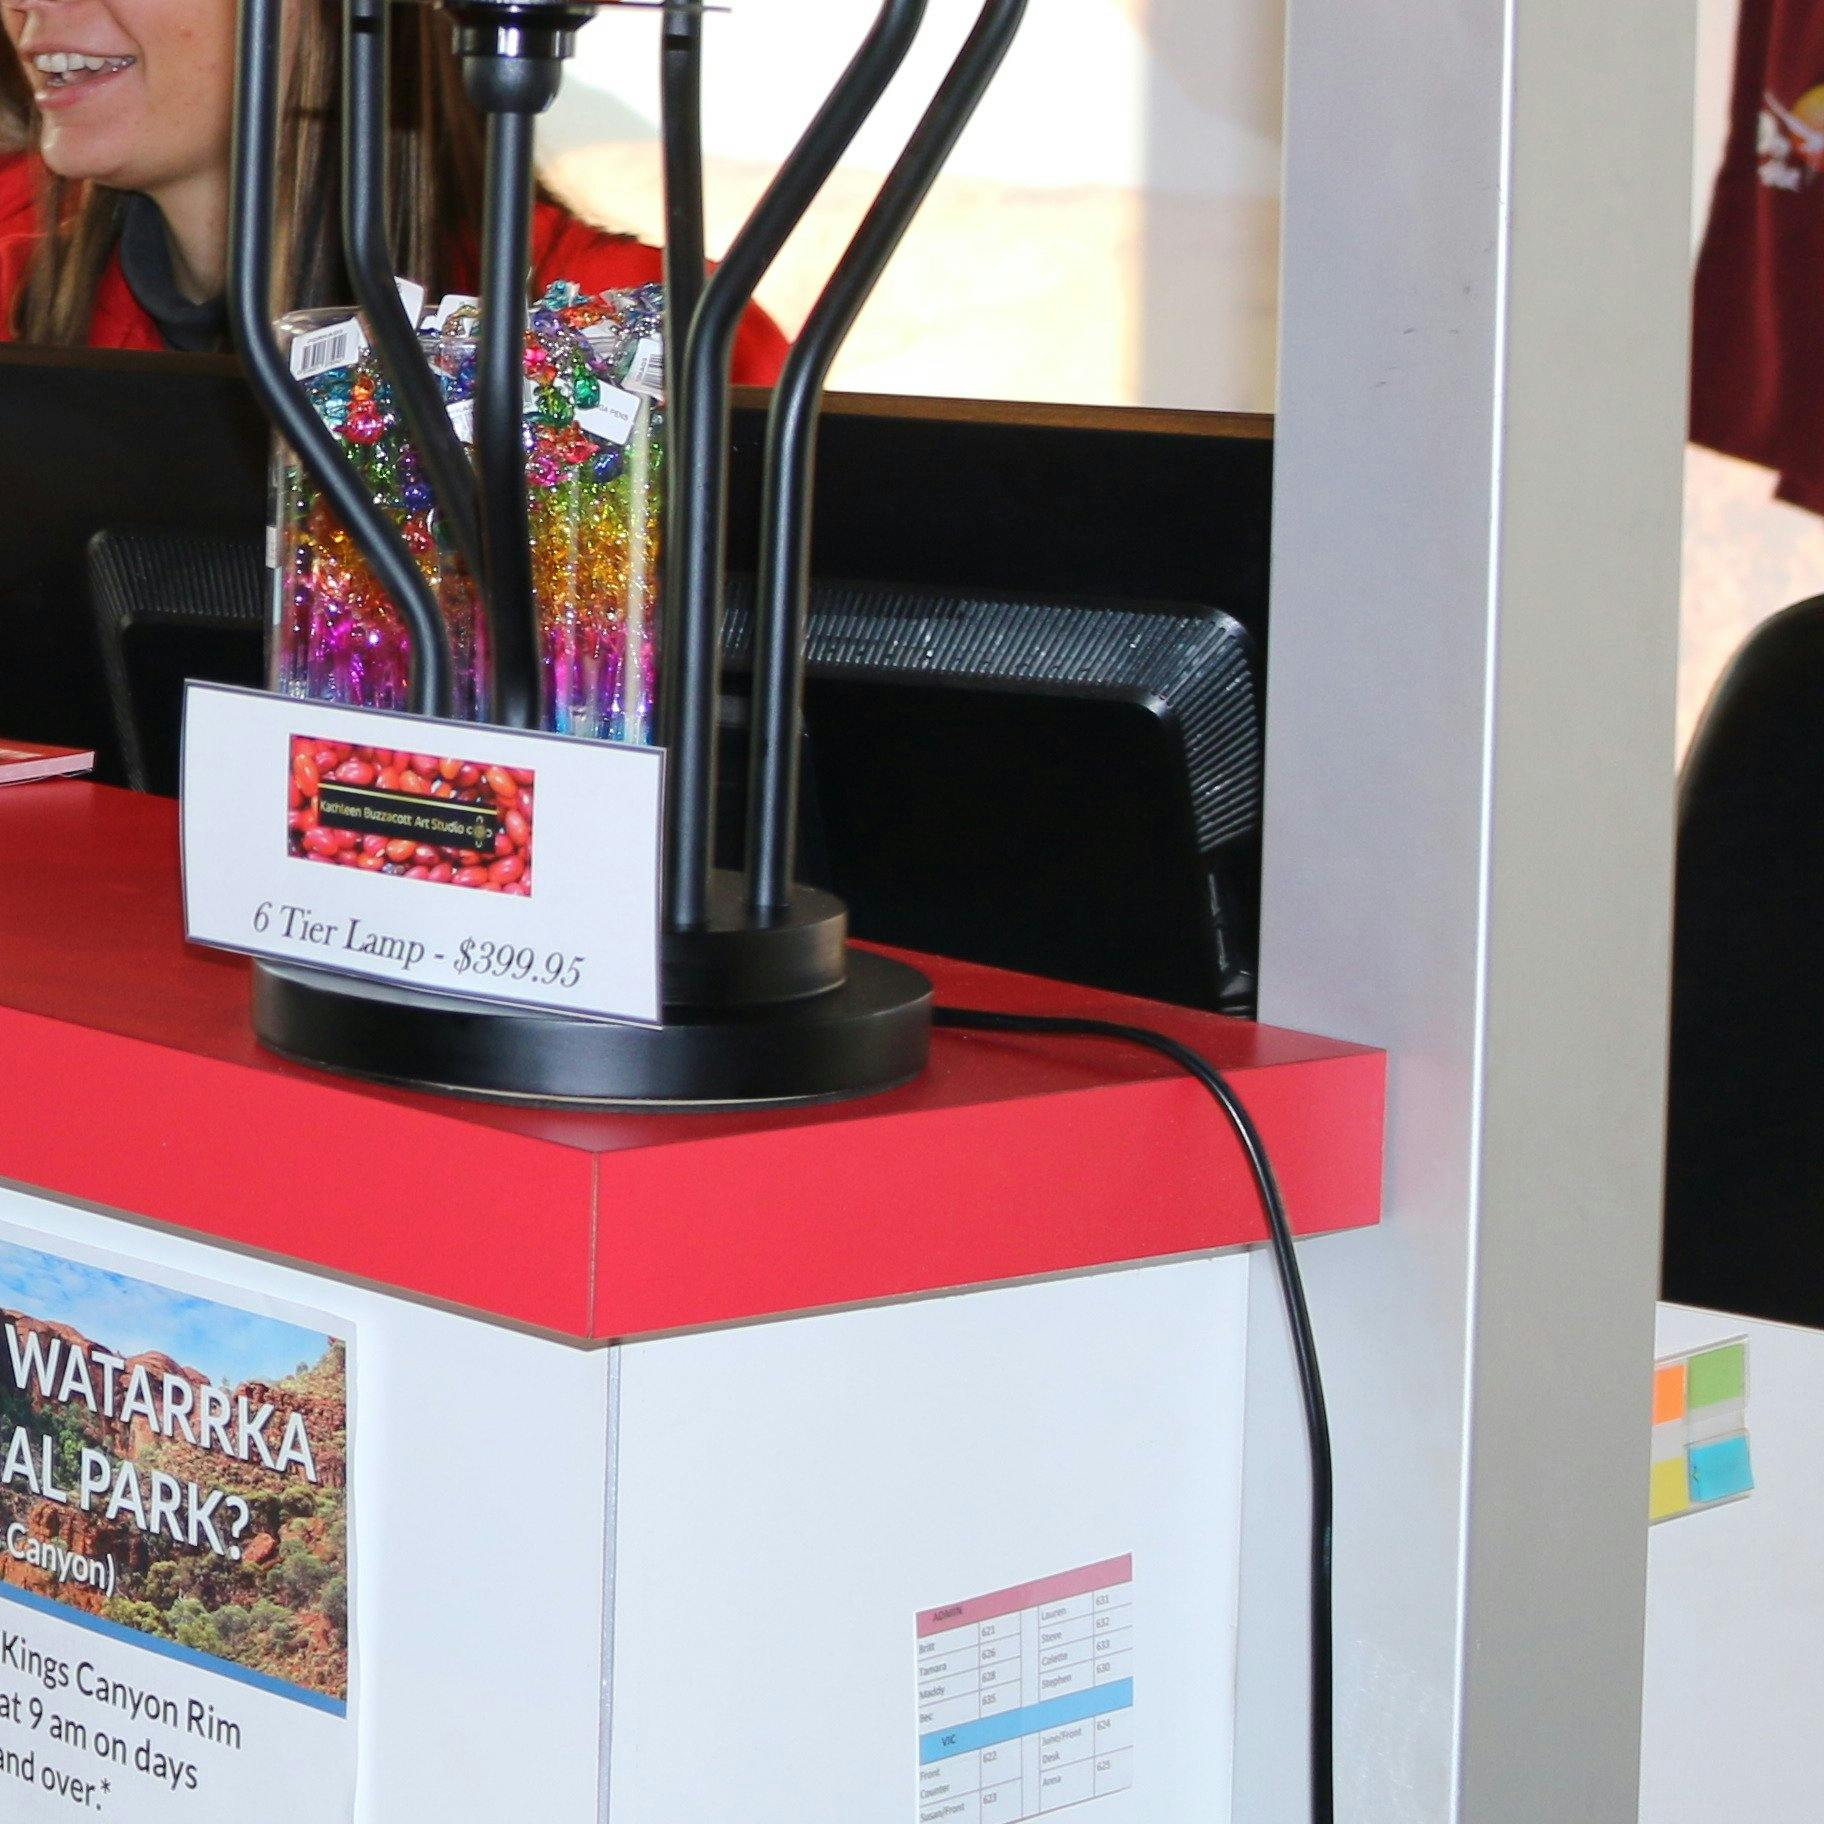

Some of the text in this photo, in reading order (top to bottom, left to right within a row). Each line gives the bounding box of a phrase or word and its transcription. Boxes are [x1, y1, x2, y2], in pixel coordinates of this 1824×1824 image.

[319, 800, 464, 835] Kathleen Buzzacott Art Studio
[253, 901, 273, 934] 6
[280, 904, 338, 946] Tier
[343, 917, 425, 970] Lamp
[453, 936, 586, 988] $399.95
[5, 1323, 318, 1484] WATARRKA
[81, 1447, 250, 1561] PARK?
[7, 1522, 114, 1596] Canyon)
[933, 1606, 962, 1622] ADMIN
[1042, 1608, 1066, 1621] Lauren
[1042, 1632, 1062, 1643] Steve
[919, 1642, 935, 1654] Britt
[919, 1663, 947, 1676] Tamara
[1042, 1675, 1072, 1689] Stephen
[2, 1630, 69, 1689] Kings
[76, 1661, 178, 1727] Canyon
[187, 1698, 241, 1749] Rim
[919, 1686, 945, 1699] Maddy
[28, 1697, 44, 1729] 9
[49, 1714, 87, 1750] am
[94, 1731, 127, 1765] on
[134, 1738, 198, 1791] days
[941, 1734, 956, 1746] VIC
[1042, 1751, 1060, 1764] Desk
[920, 1769, 940, 1780] Front
[920, 1784, 950, 1799] Counter
